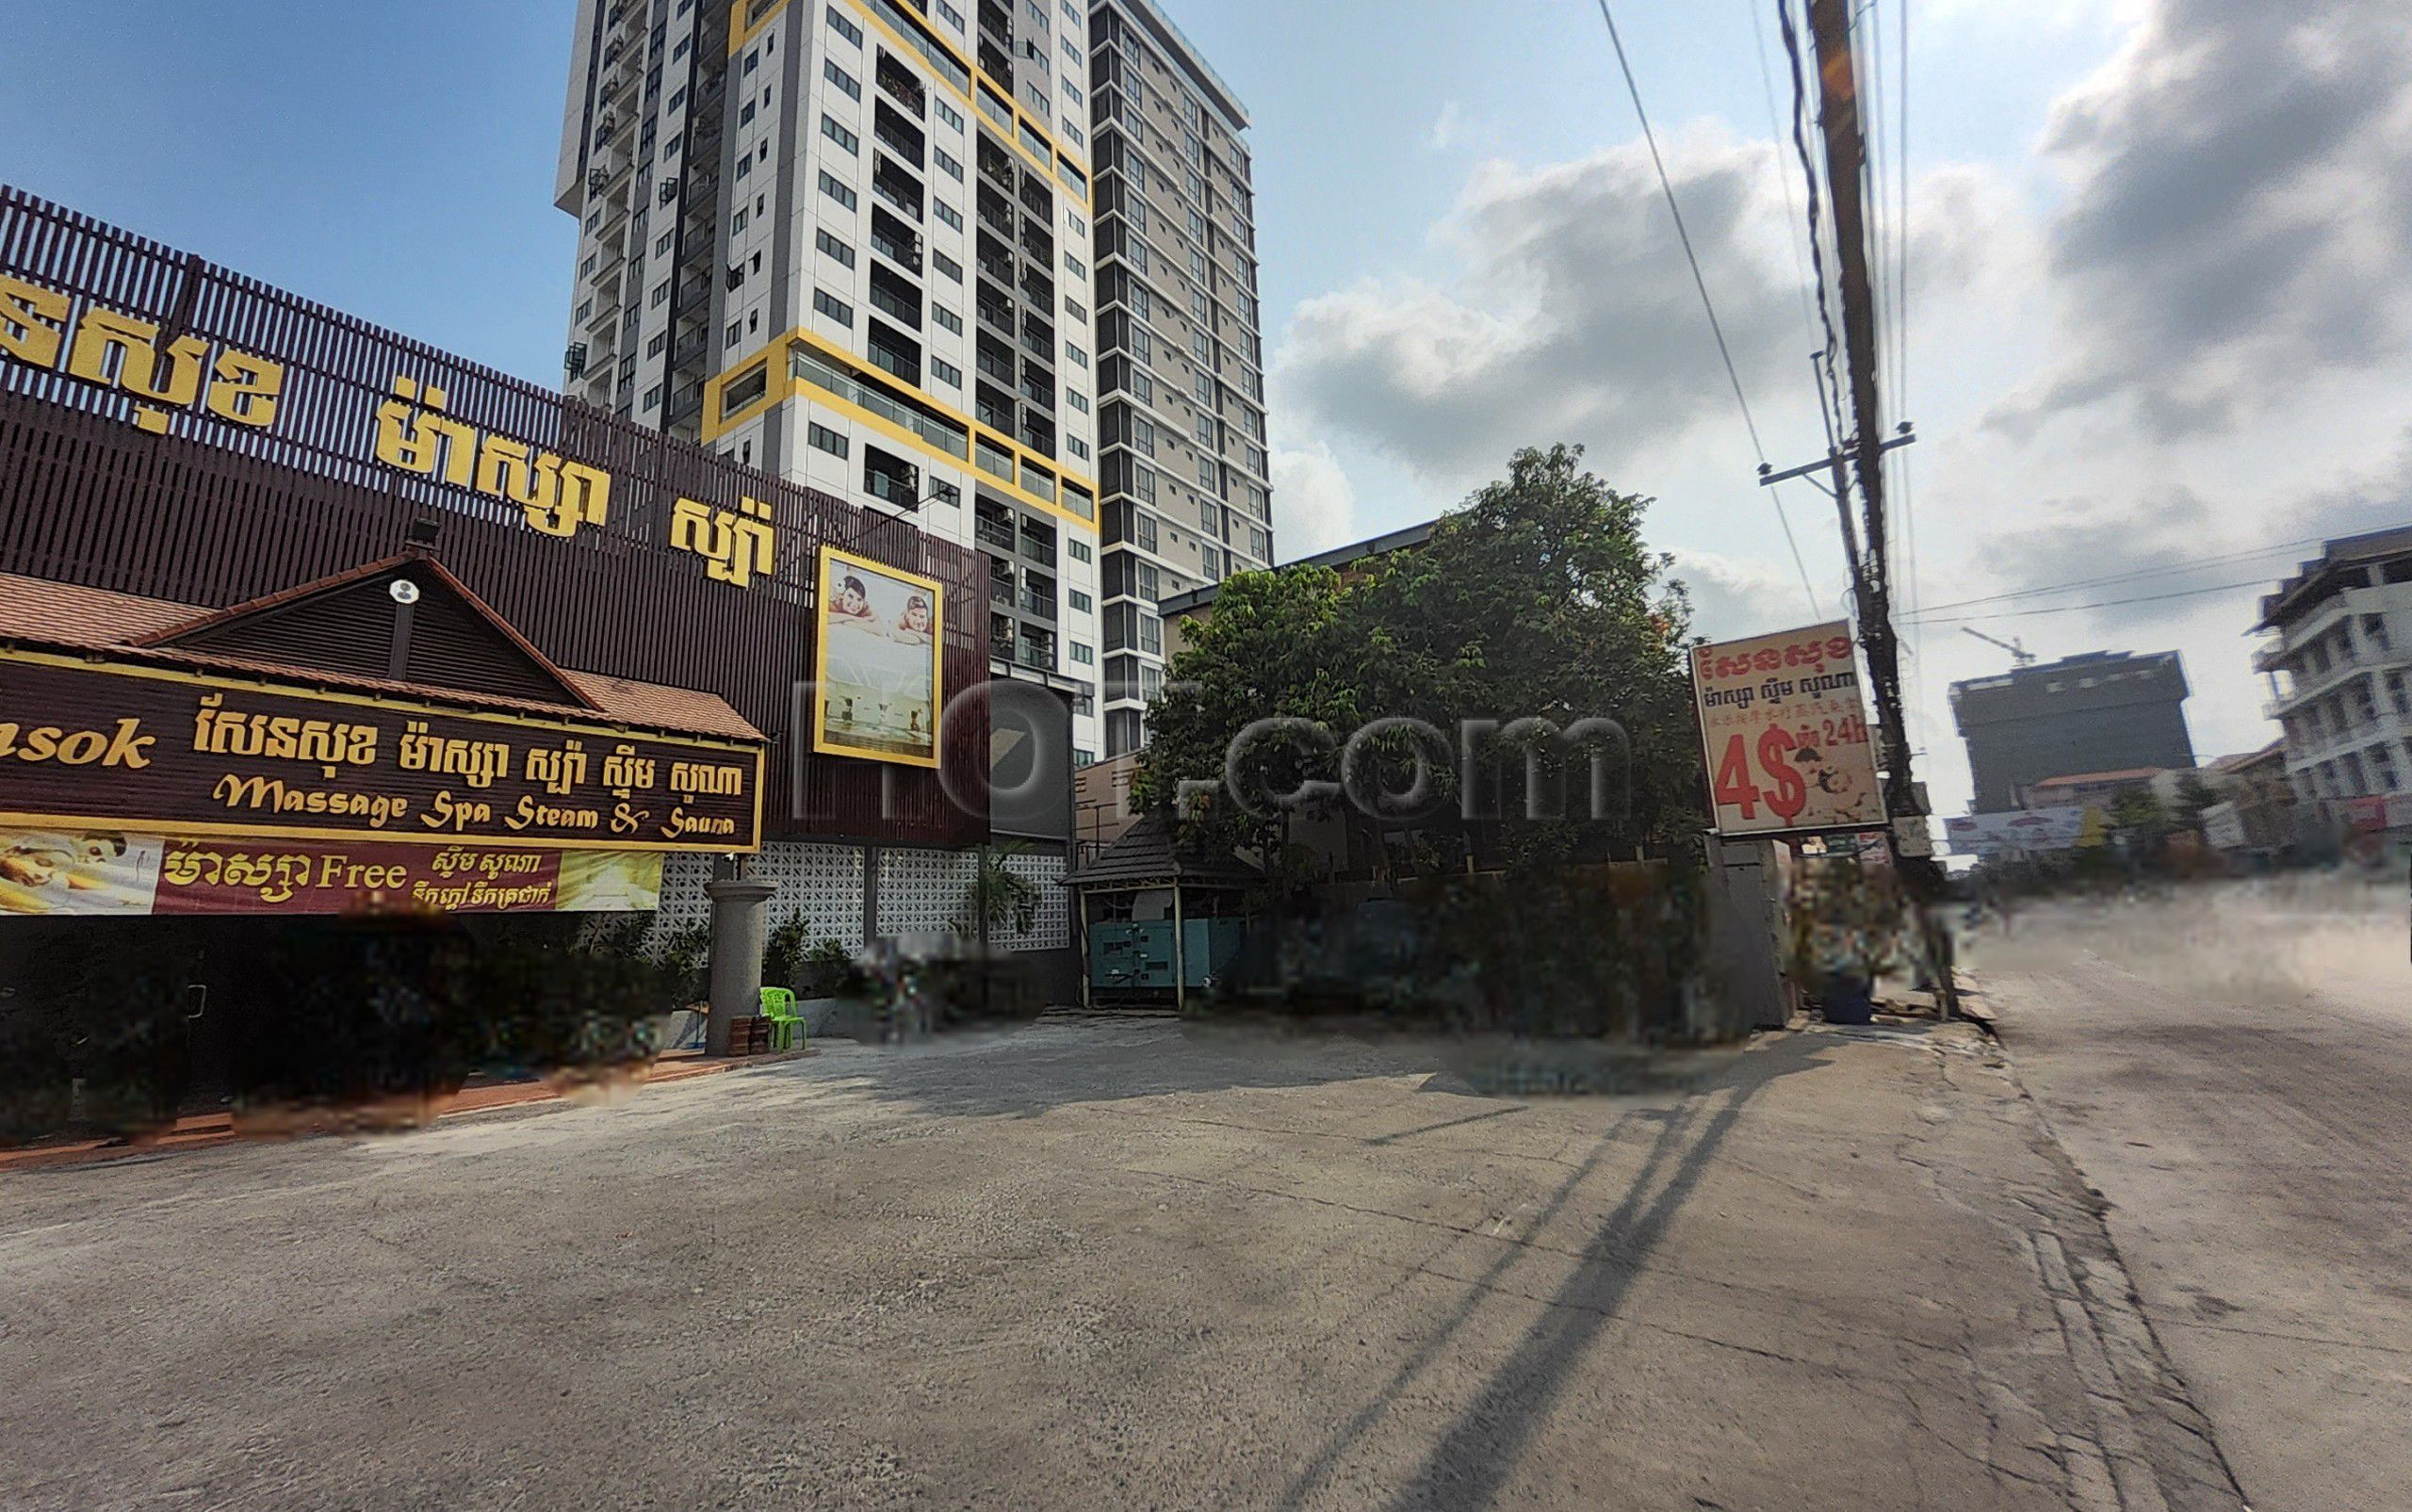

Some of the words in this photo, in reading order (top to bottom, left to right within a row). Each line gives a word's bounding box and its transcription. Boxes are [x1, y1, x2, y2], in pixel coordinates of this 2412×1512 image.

[213, 774, 408, 828] Massage
[421, 790, 491, 831] Spa
[504, 796, 598, 830] Steam
[611, 803, 650, 834] &
[660, 807, 735, 838] Sauna
[315, 854, 408, 888] Free
